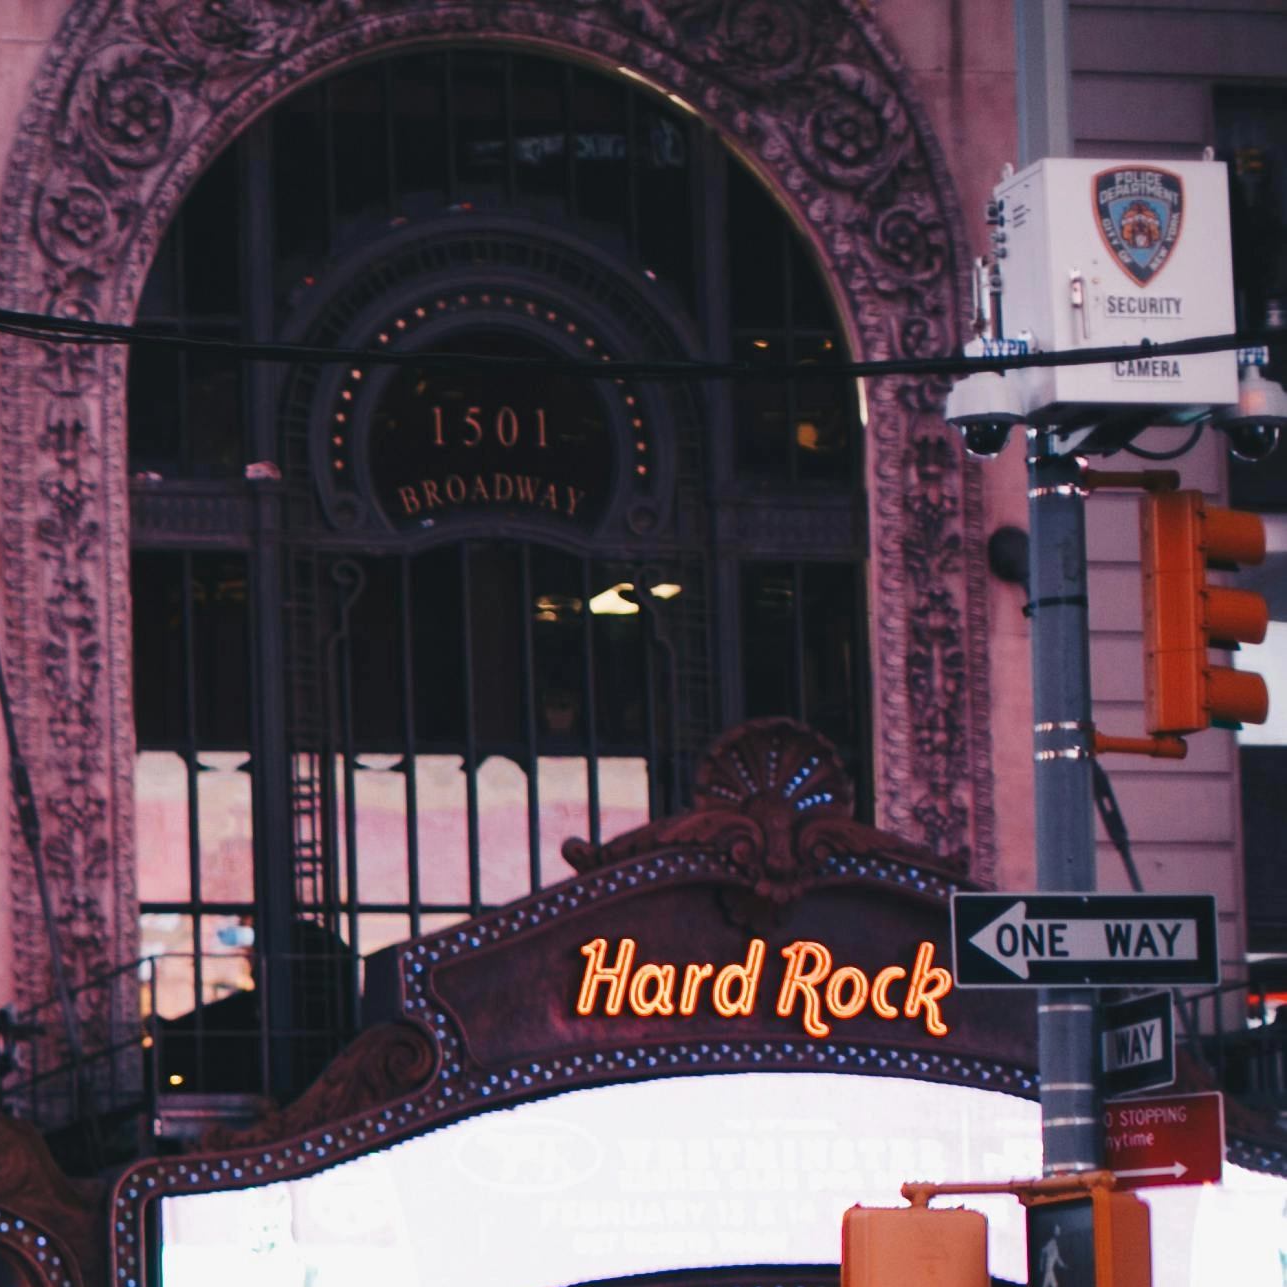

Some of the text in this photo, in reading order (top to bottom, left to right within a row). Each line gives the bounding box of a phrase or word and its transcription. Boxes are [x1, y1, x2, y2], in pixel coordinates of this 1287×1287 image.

[1115, 171, 1163, 186] POLICE
[1099, 183, 1178, 205] DEPARTMENT
[1108, 295, 1183, 315] SECURITY
[1115, 360, 1182, 378] CAMERA
[433, 405, 547, 447] 1501
[398, 472, 586, 516] BROADWAY
[996, 922, 1182, 957] ONE WAY
[576, 938, 954, 1039] Hard Rock
[1115, 1023, 1156, 1067] WAY
[1120, 1105, 1187, 1126] STOPPING
[1106, 1132, 1155, 1152] nytime
